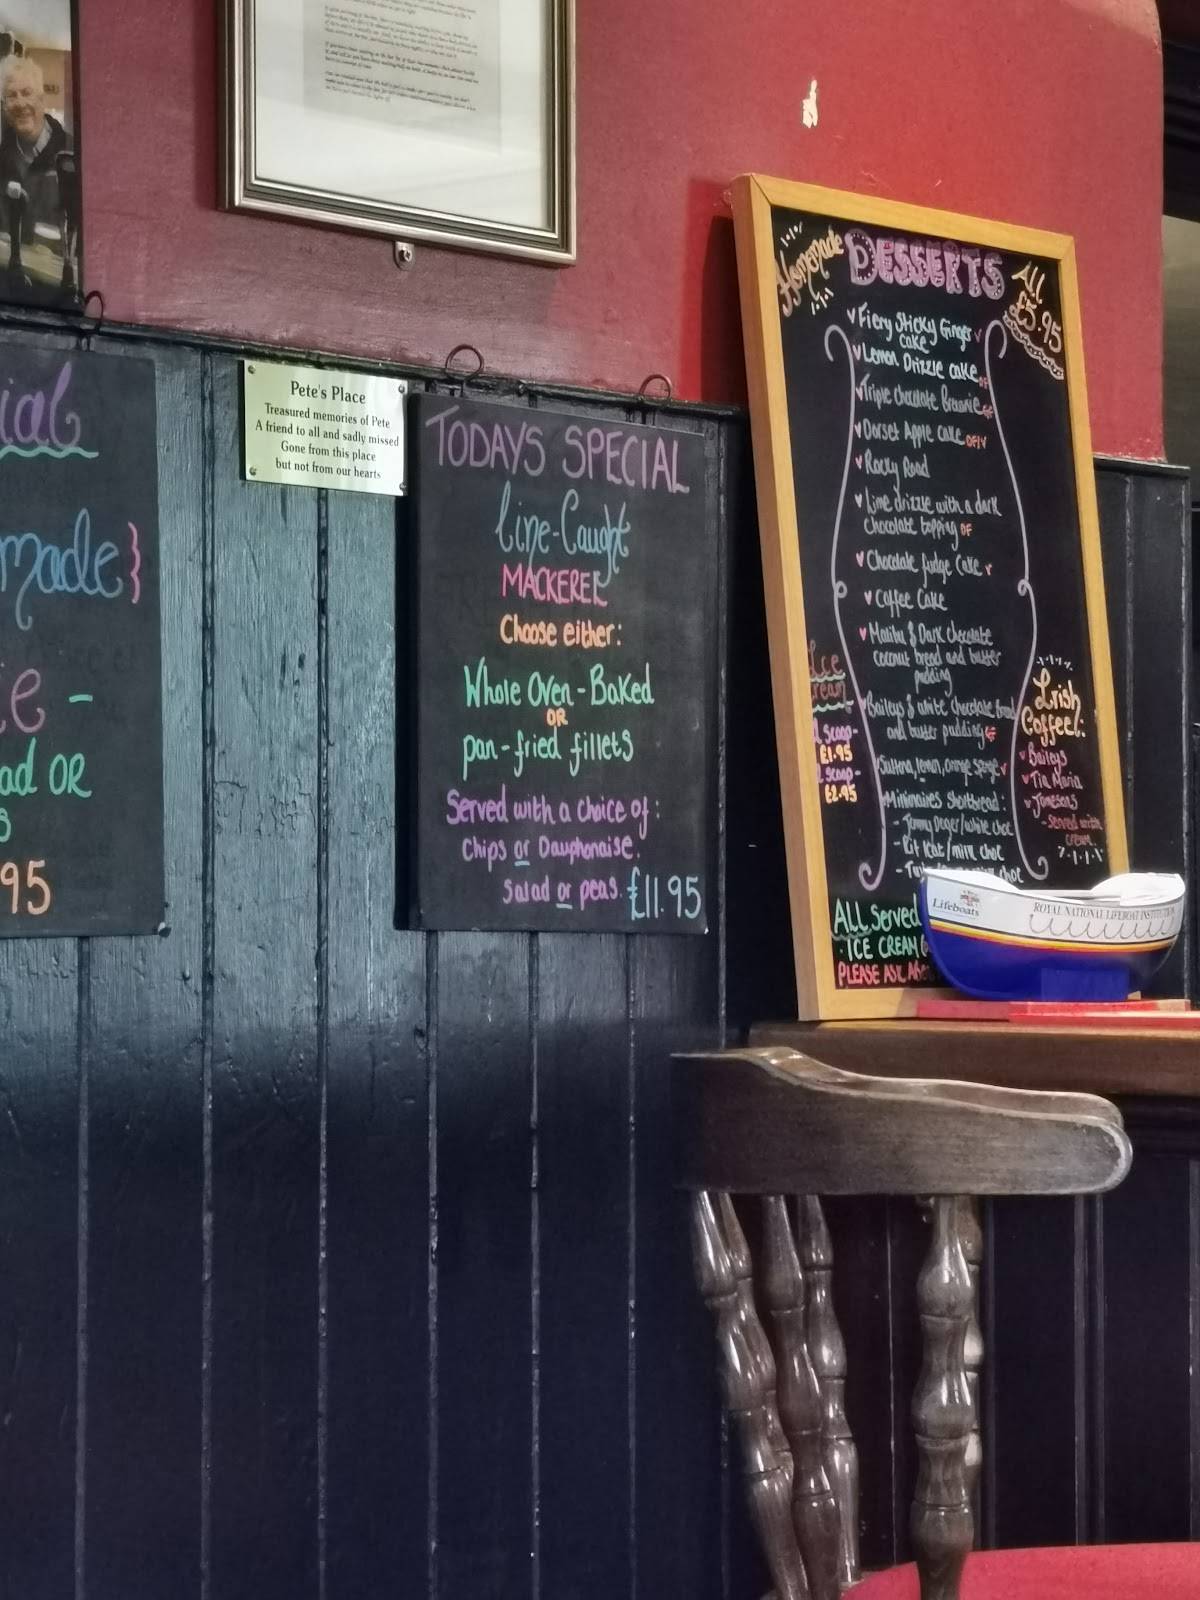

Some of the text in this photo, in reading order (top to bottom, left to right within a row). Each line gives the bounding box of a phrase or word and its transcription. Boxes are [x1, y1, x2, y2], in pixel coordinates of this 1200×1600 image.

[844, 228, 1005, 300] DESSERTS
[862, 342, 899, 367] Lemon
[903, 353, 945, 379] Drizzle
[291, 380, 366, 404] Pete's Place
[265, 403, 390, 429] Treasured memories of Pete
[256, 420, 399, 447] A friend to all and sadly missed
[863, 418, 900, 441] Dorset
[904, 420, 934, 449] Apple
[281, 440, 376, 462] Gone from this place
[426, 405, 690, 494] TODAYS SPECIAL
[275, 458, 381, 479] but not from our hearts
[903, 453, 931, 479] Road
[936, 495, 963, 514] with
[965, 499, 974, 514] a
[920, 516, 959, 552] topping
[500, 613, 622, 648] Choose either:
[918, 622, 946, 645] Dark
[914, 643, 943, 667] bread
[946, 645, 967, 666] and
[969, 647, 1001, 667] butter
[464, 656, 521, 708] Whole
[914, 665, 953, 698] pudding
[546, 707, 568, 727] OR
[887, 719, 907, 741] and
[908, 721, 938, 741] butter
[943, 717, 985, 750] pudding
[570, 729, 634, 777] fillets
[49, 753, 92, 797] OR
[447, 784, 508, 825] Served
[513, 793, 556, 825] with
[559, 801, 572, 823] a
[514, 840, 530, 859] or
[557, 882, 571, 902] or
[627, 866, 702, 920] £11.95
[870, 892, 922, 932] Served
[933, 898, 979, 916] Lifeboats
[1033, 902, 1061, 915] ROYAL
[1065, 905, 1103, 919] NATIONAL
[846, 938, 874, 961] ICE
[878, 934, 920, 959] CREAM
[838, 961, 880, 987] PLEASE
